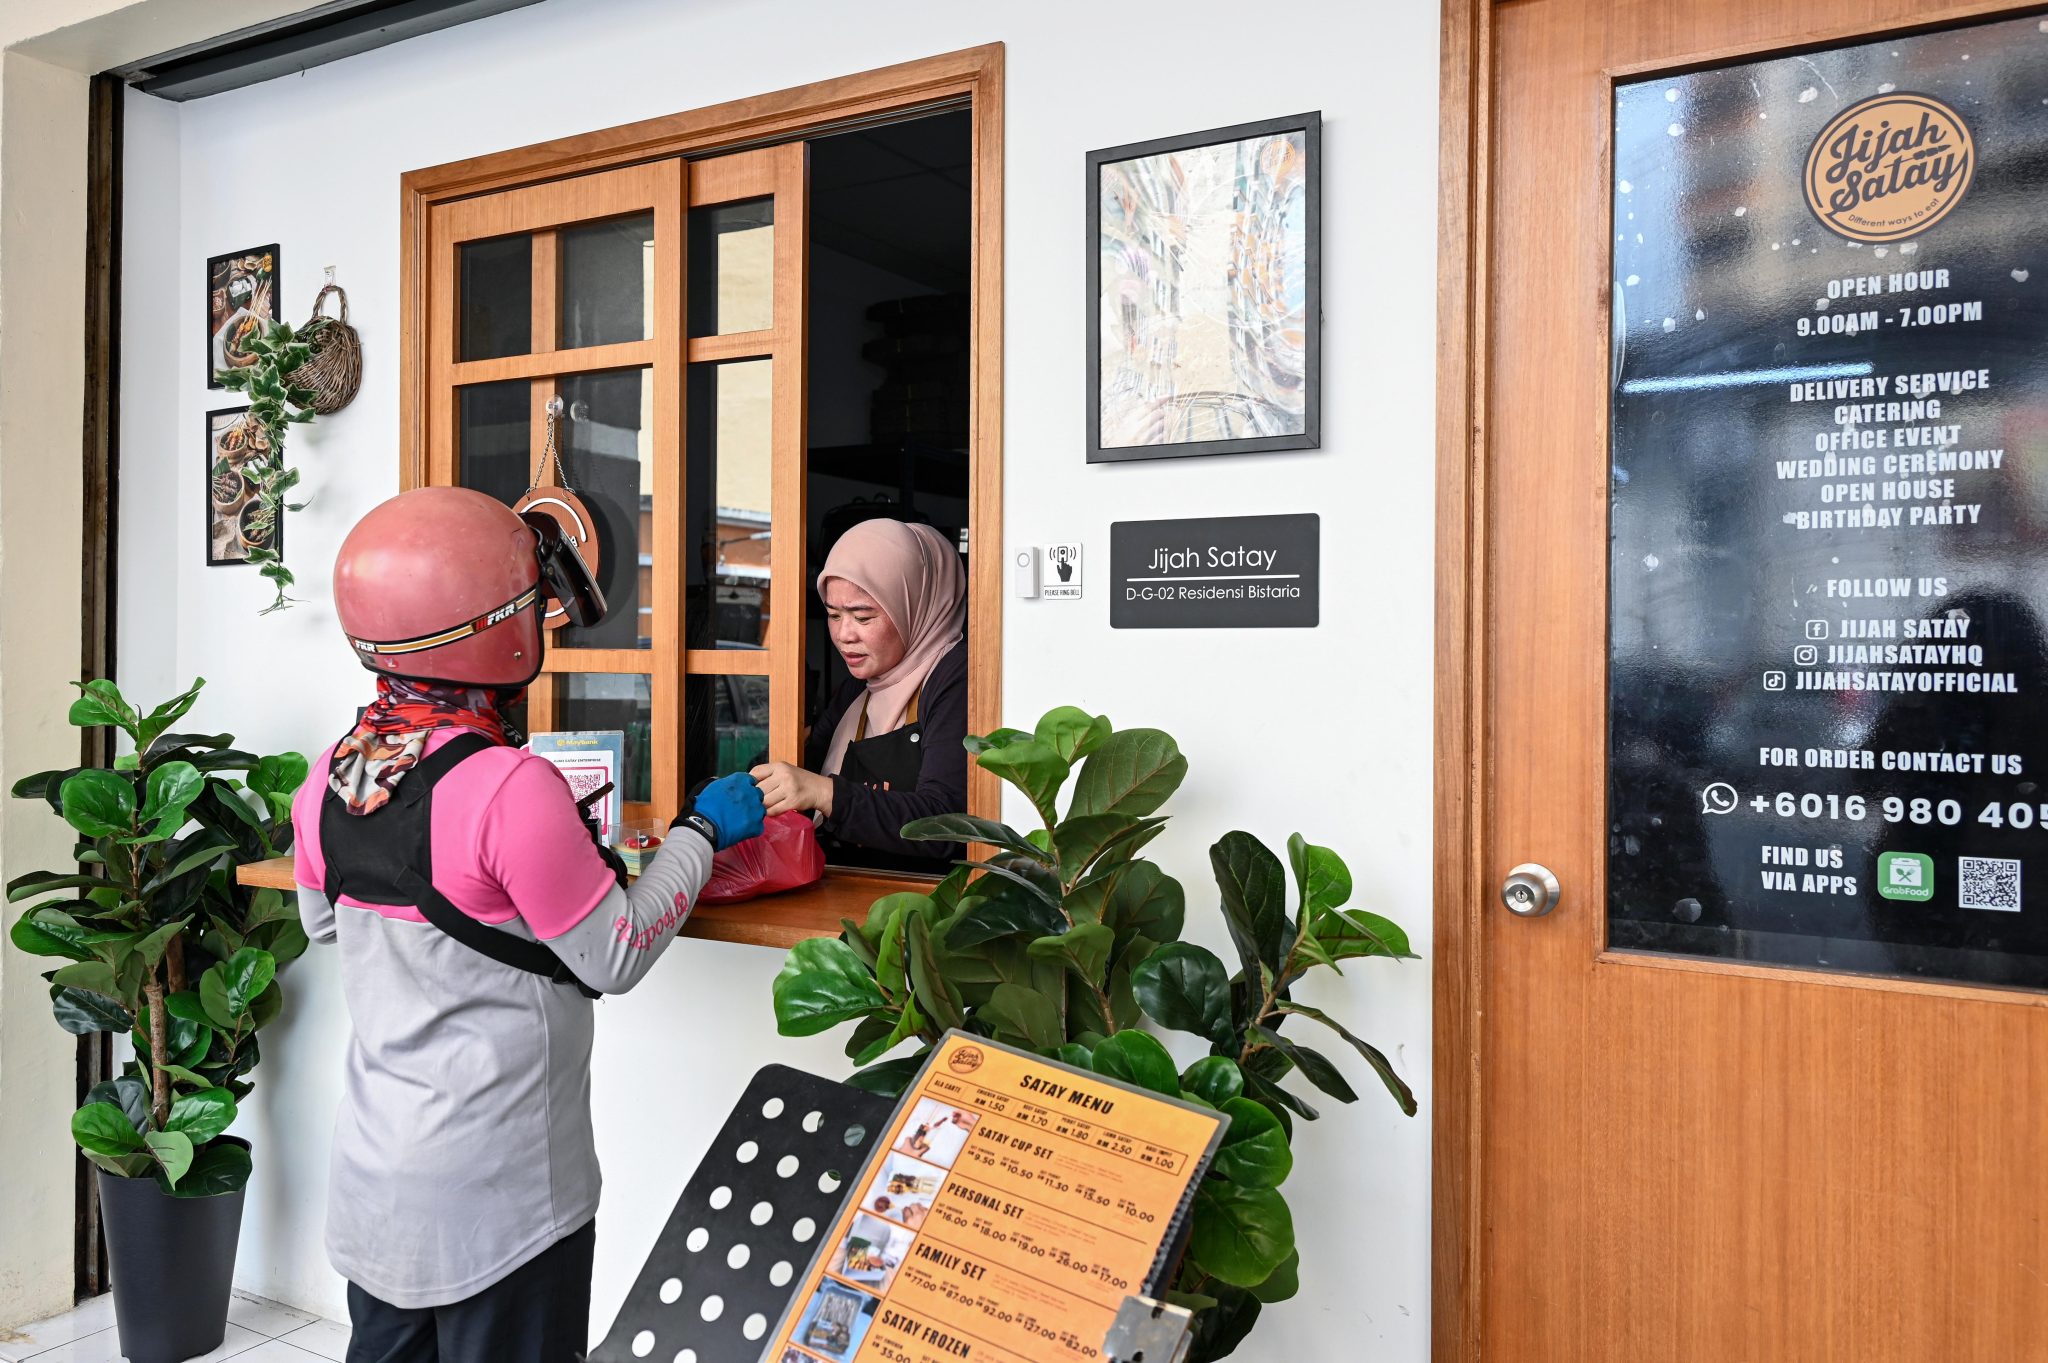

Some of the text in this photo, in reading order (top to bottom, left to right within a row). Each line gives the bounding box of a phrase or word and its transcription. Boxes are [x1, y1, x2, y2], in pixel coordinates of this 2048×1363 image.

[1826, 112, 1947, 184] Jijah
[1828, 153, 1960, 213] Satay
[1848, 198, 1939, 227] Different ways to eat
[1827, 269, 1950, 299] OPEN HOUR
[1796, 311, 1878, 337] 9.00AM
[1900, 301, 1983, 327] 7.00PM
[1790, 369, 1990, 402] DELIVERY SERVICE
[1834, 399, 1941, 425] CATERING
[1815, 425, 1962, 452] OFFICE EVENT
[1776, 449, 2004, 480] WEDDING CEREMONY
[1820, 479, 1955, 503] OPEN HOUSE
[1796, 504, 1982, 529] BIRTHDAY PARTY
[1148, 545, 1277, 574] Jijah Satay
[1126, 585, 1300, 601] D-G-02 Residensi Bistaria
[1827, 577, 1948, 597] FOLLOW US
[486, 602, 515, 626] FKR
[1839, 618, 1971, 638] JIJAH SATAY
[1827, 645, 1983, 667] JIJAHSATAYHQ
[1795, 671, 2018, 693] JIJAHSATAYOFFICIAL
[1759, 747, 2023, 775] FOR ORDER CONTACT US
[1750, 792, 1867, 821] +6016
[1882, 796, 1962, 825] 980
[1761, 845, 1844, 869] FIND US
[1760, 870, 1857, 896] VIA APPS
[1883, 886, 1929, 897] GrabFood
[989, 1100, 1005, 1111] 1.50
[1020, 1074, 1115, 1115] SATAY MENU
[1031, 1115, 1048, 1126] 1.70
[978, 1126, 1010, 1145] SATAY
[1010, 1137, 1033, 1152] CUP
[1033, 1145, 1054, 1160] SET
[1071, 1128, 1089, 1140] 1.80
[974, 1153, 995, 1166] 9.50
[1111, 1142, 1132, 1155] 2.50
[1007, 1164, 1033, 1179] 10.50
[1155, 1156, 1174, 1169] 1.00
[1044, 1177, 1069, 1192] 11.30
[947, 1182, 1001, 1212] PERSONAL
[1002, 1202, 1025, 1219] SET
[1083, 1191, 1110, 1206] 15.50
[942, 1212, 968, 1227] 16.00
[1125, 1206, 1154, 1223] 10.00
[980, 1226, 1006, 1242] 18.00
[1017, 1240, 1045, 1257] 19.00
[915, 1243, 987, 1281] FAMILY SET
[1056, 1255, 1088, 1273] 26.00
[910, 1275, 937, 1291] 77.00
[1099, 1272, 1128, 1289] 17.00
[945, 1290, 974, 1307] 87.00
[983, 1305, 1013, 1323] 92.00
[881, 1309, 922, 1336] SATAY
[921, 1327, 971, 1358] FROZEN
[1065, 1339, 1097, 1358] 82.00
